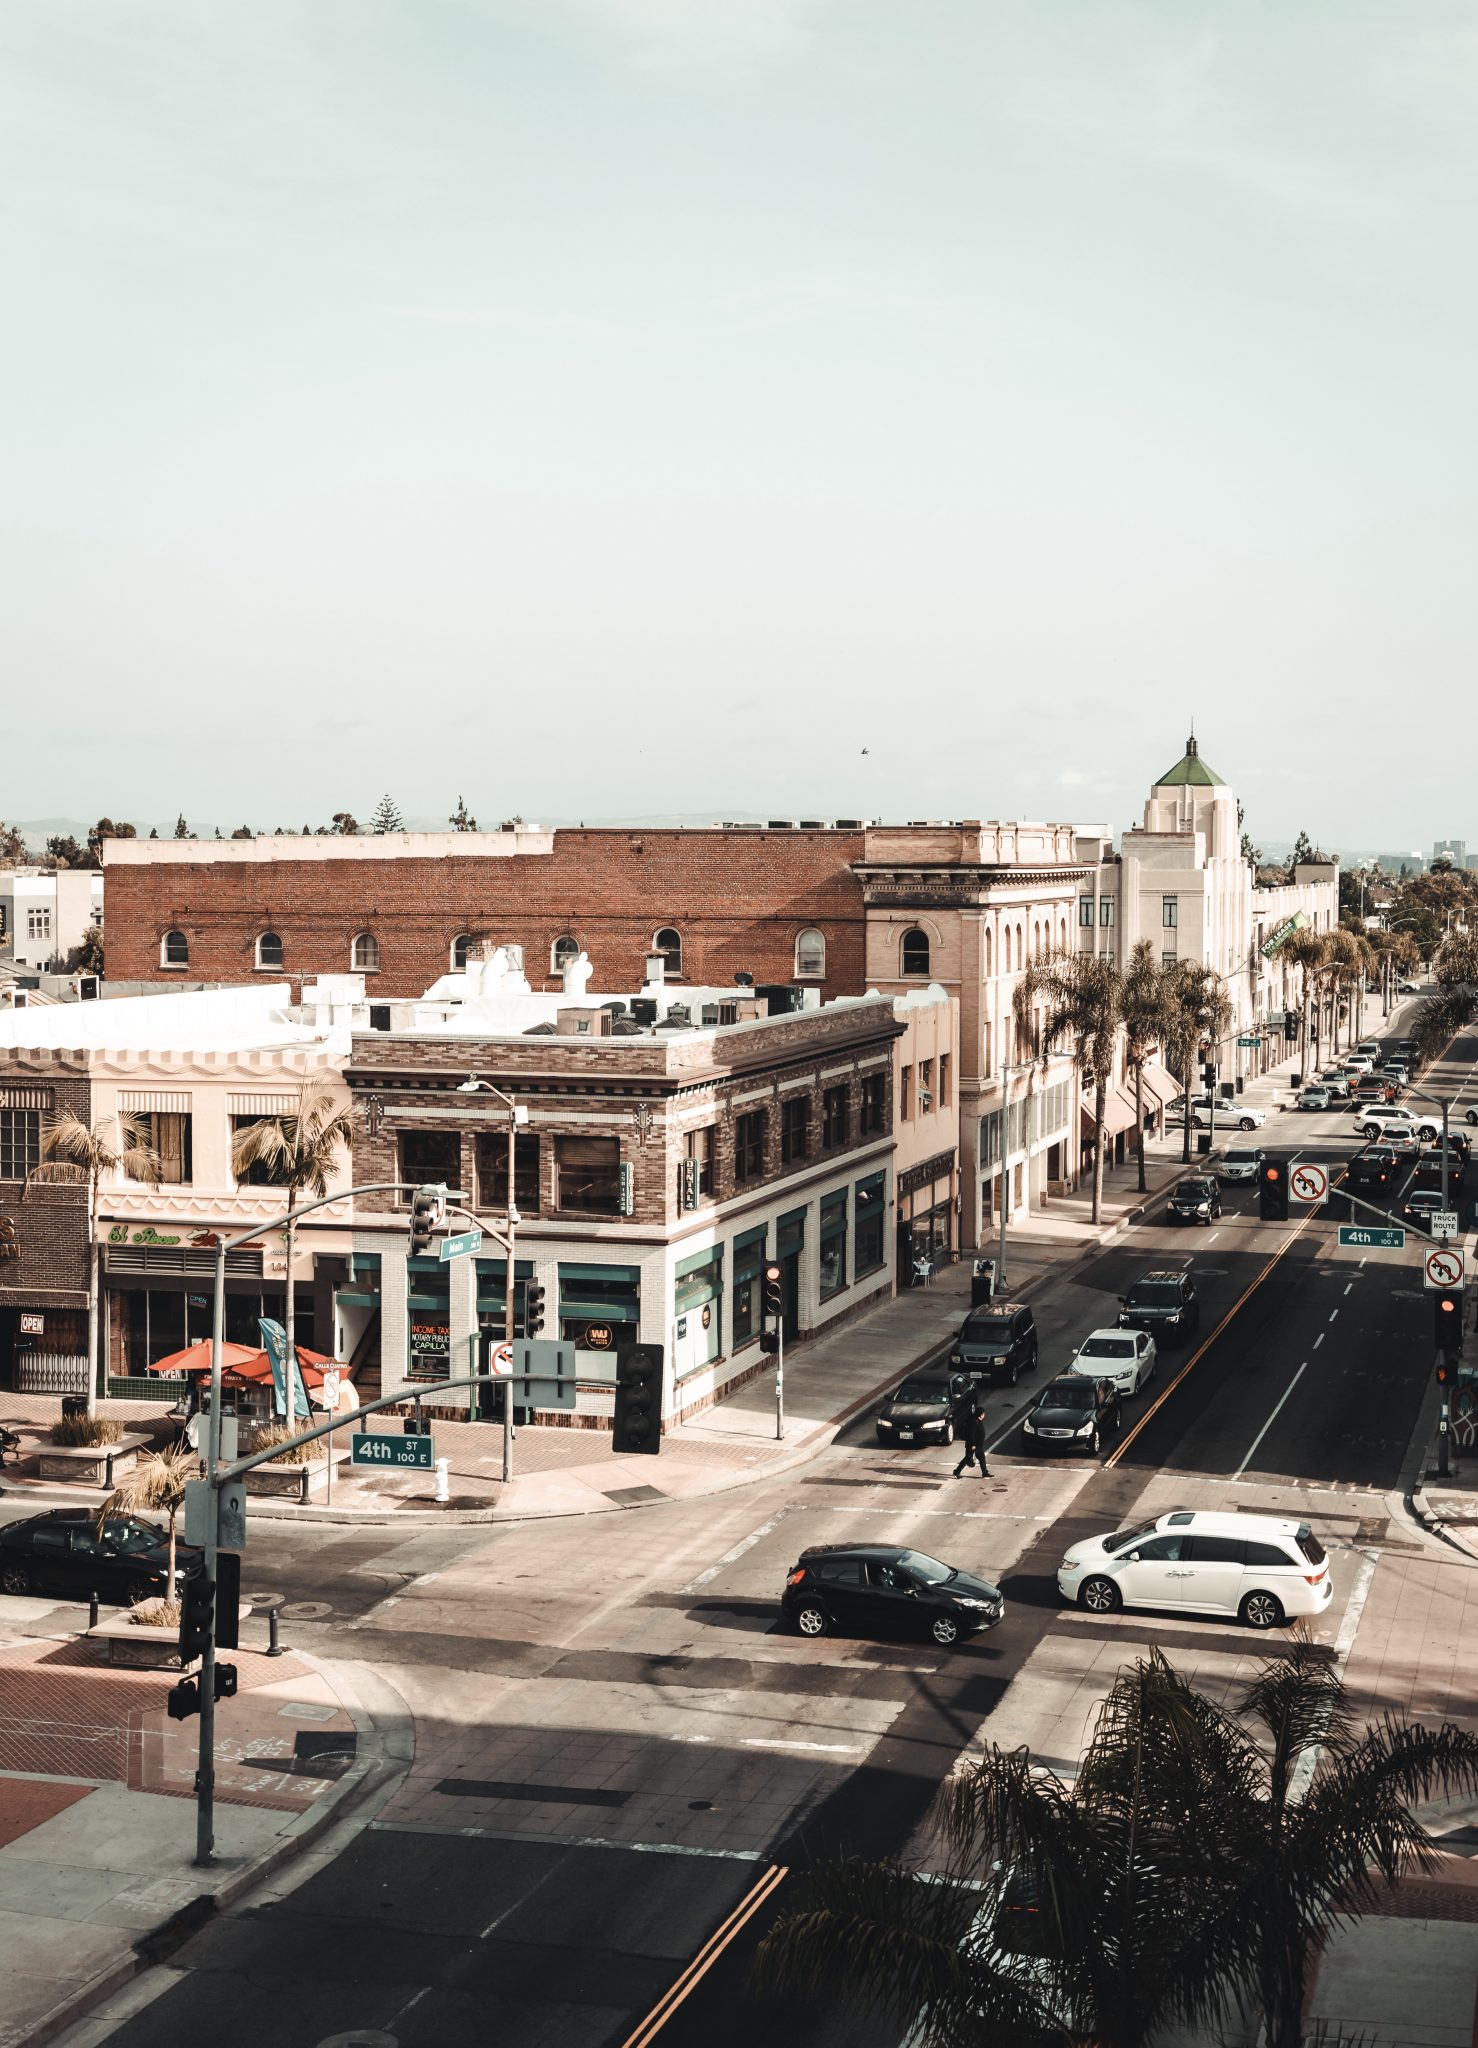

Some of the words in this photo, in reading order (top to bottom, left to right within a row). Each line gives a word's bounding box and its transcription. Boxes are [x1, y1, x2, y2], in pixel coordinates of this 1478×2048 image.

[1261, 938, 1275, 953] FOR
[1274, 921, 1293, 940] LEASE
[686, 1161, 694, 1202] DENTAL
[108, 1225, 128, 1244] El
[1348, 1232, 1370, 1243] 4th
[449, 1241, 463, 1254] Main
[190, 1296, 208, 1304] OPEN
[23, 1316, 42, 1332] OPEN
[412, 1325, 436, 1334] INCOME
[438, 1326, 450, 1334] TAX
[432, 1334, 450, 1343] PUBLIC
[359, 1441, 391, 1458] 4th
[406, 1441, 418, 1450] ST
[397, 1453, 415, 1462] 100
[420, 1454, 426, 1463] E
